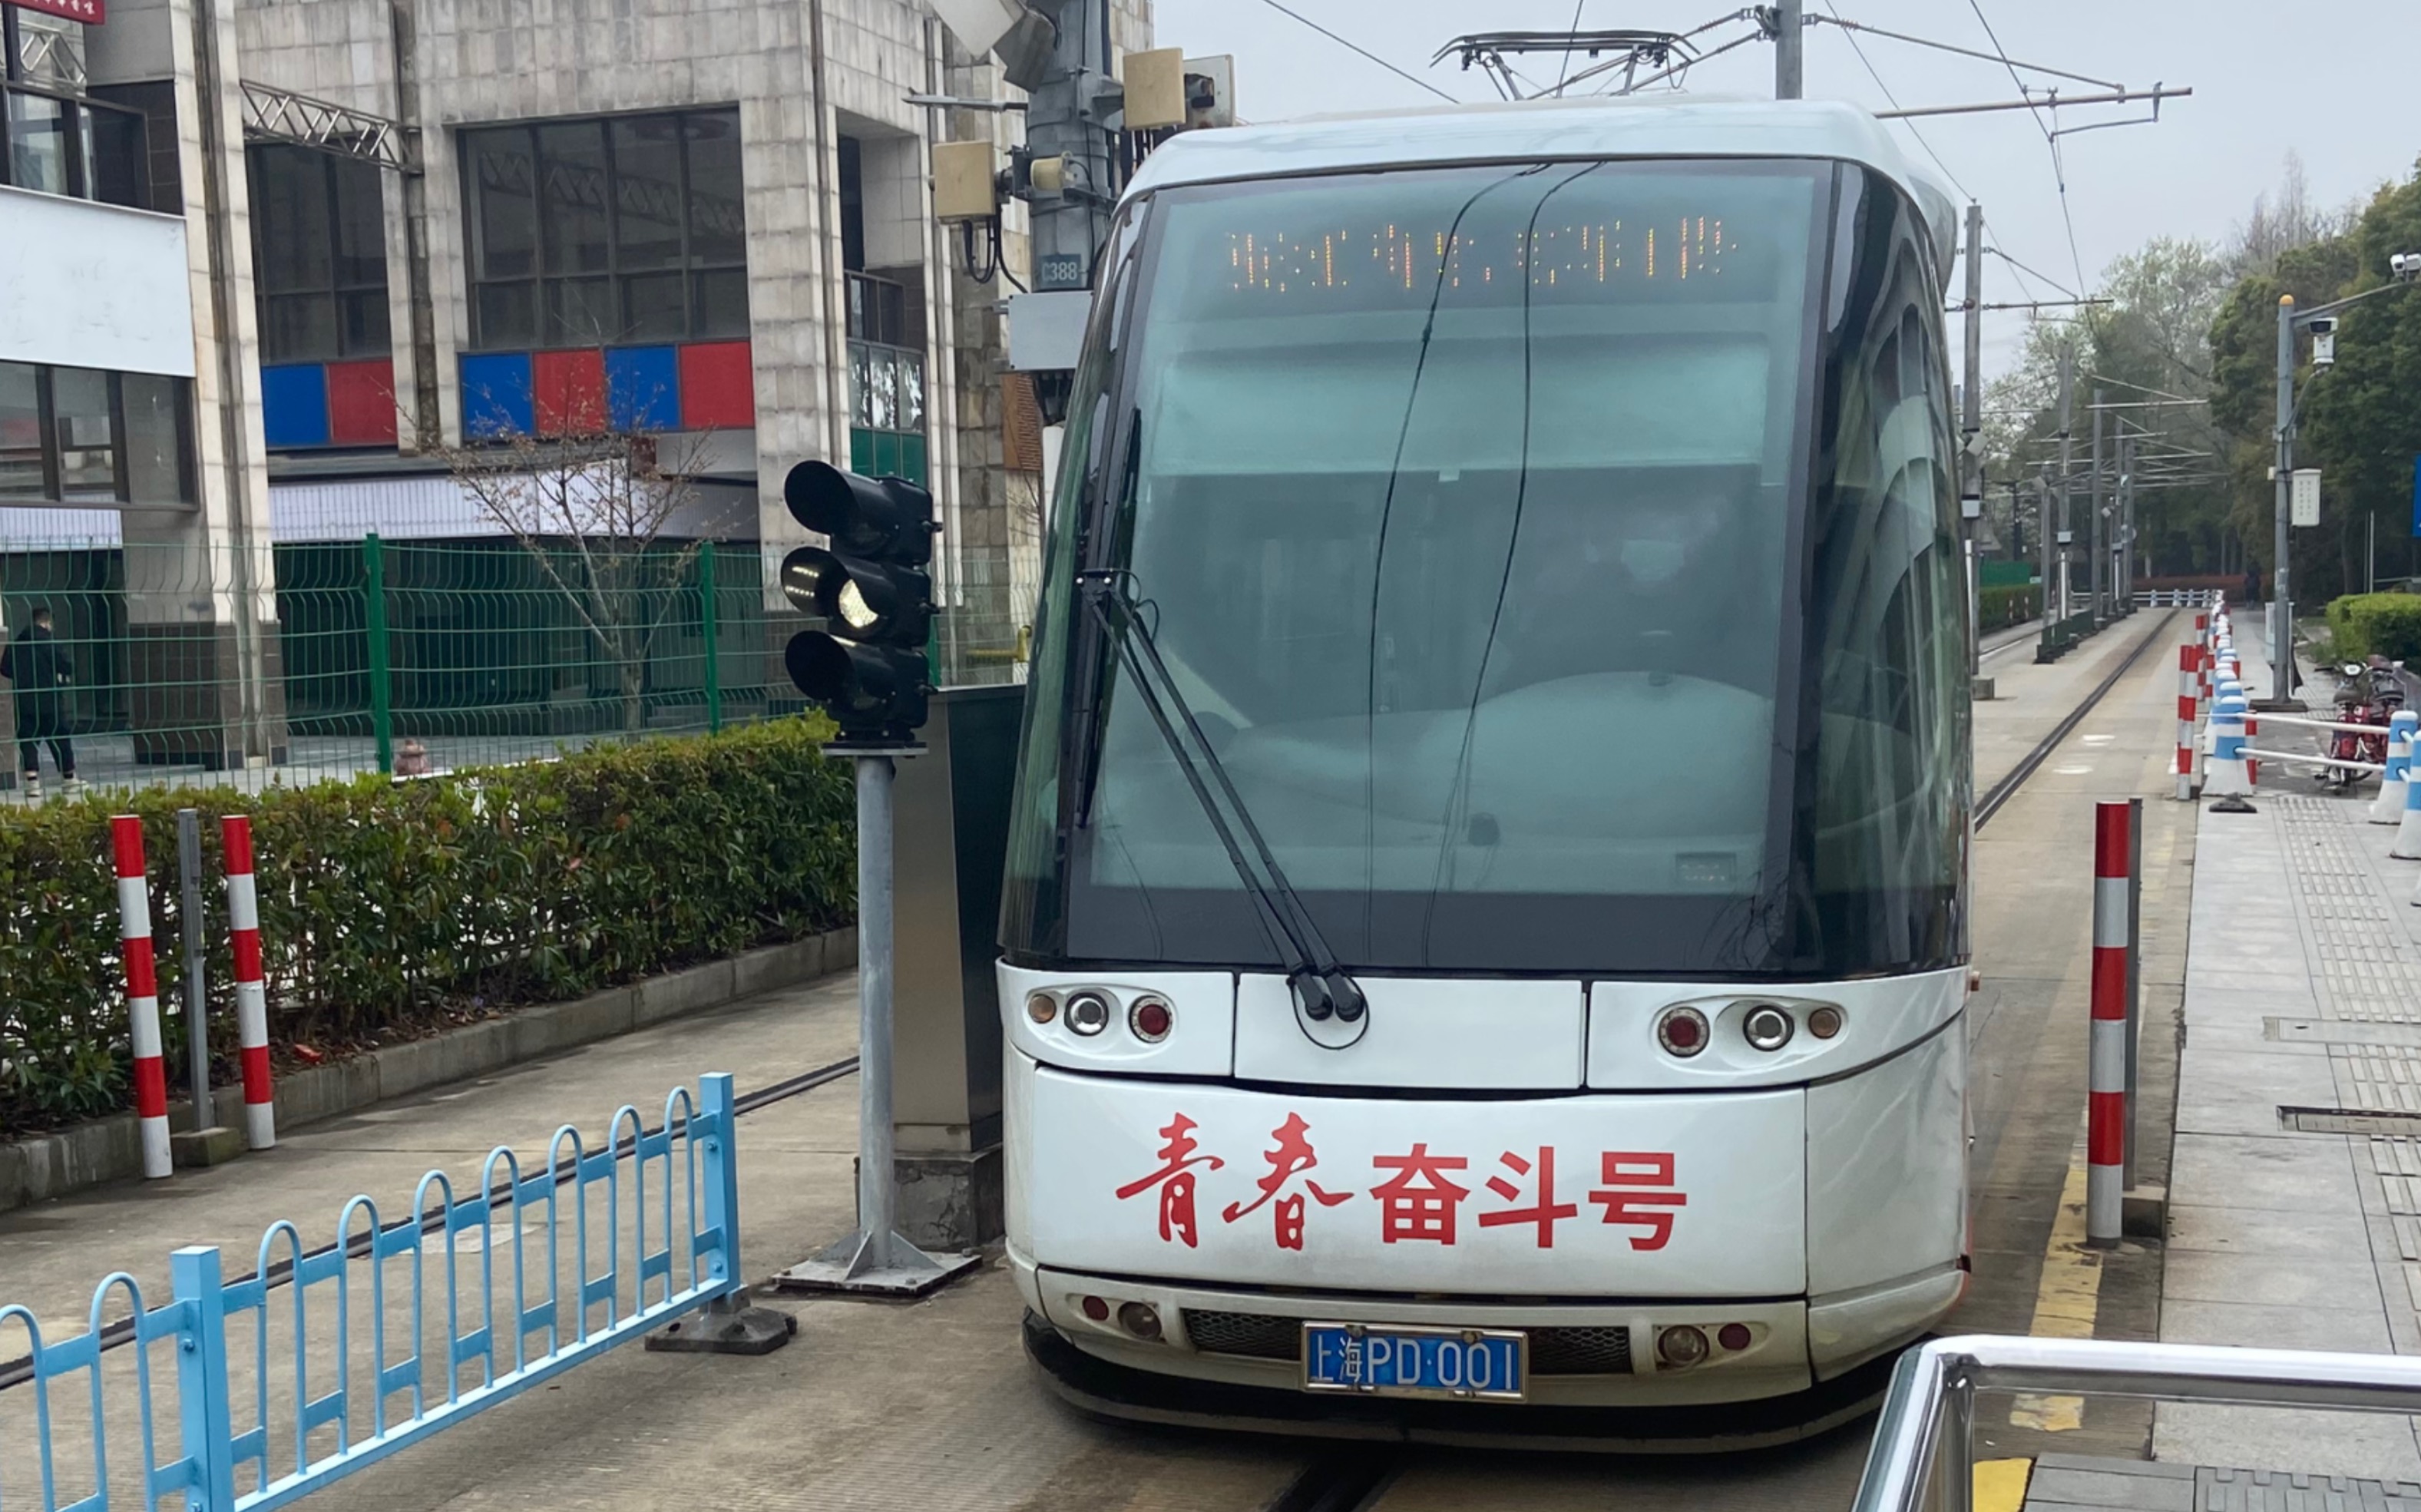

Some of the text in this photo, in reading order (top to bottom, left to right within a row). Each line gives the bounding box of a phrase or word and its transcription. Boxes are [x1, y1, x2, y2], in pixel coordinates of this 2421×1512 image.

[1116, 1112, 1687, 1251] 青春奋斗号
